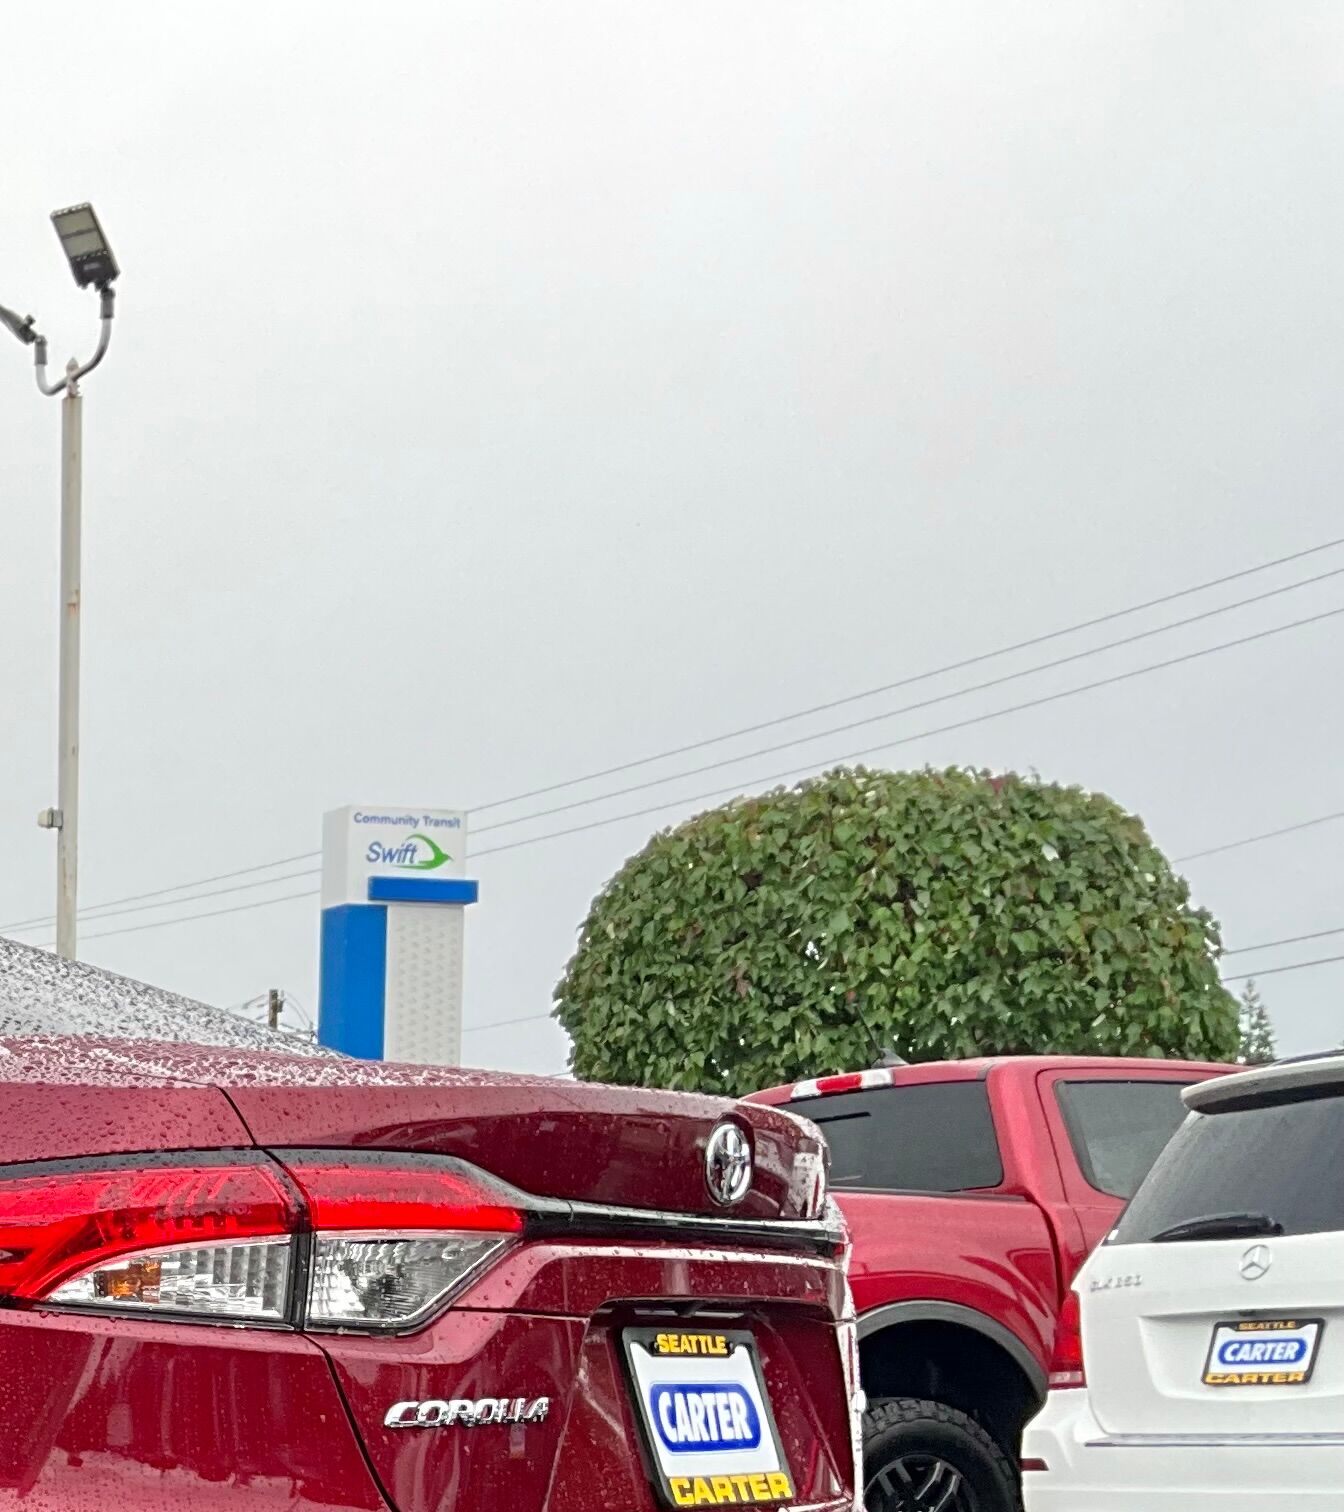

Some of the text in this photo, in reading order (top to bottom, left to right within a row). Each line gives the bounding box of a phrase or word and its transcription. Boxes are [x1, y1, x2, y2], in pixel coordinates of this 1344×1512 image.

[353, 812, 461, 829] Community Transit
[365, 841, 419, 865] Swift
[1238, 1321, 1297, 1331] SEATTLE
[655, 1333, 728, 1354] SEATTLE
[1224, 1341, 1300, 1363] CARTER
[1205, 1371, 1305, 1385] CARTER
[384, 1397, 550, 1428] COROLLA
[658, 1391, 753, 1443] CARTER
[669, 1472, 793, 1505] CARTER
